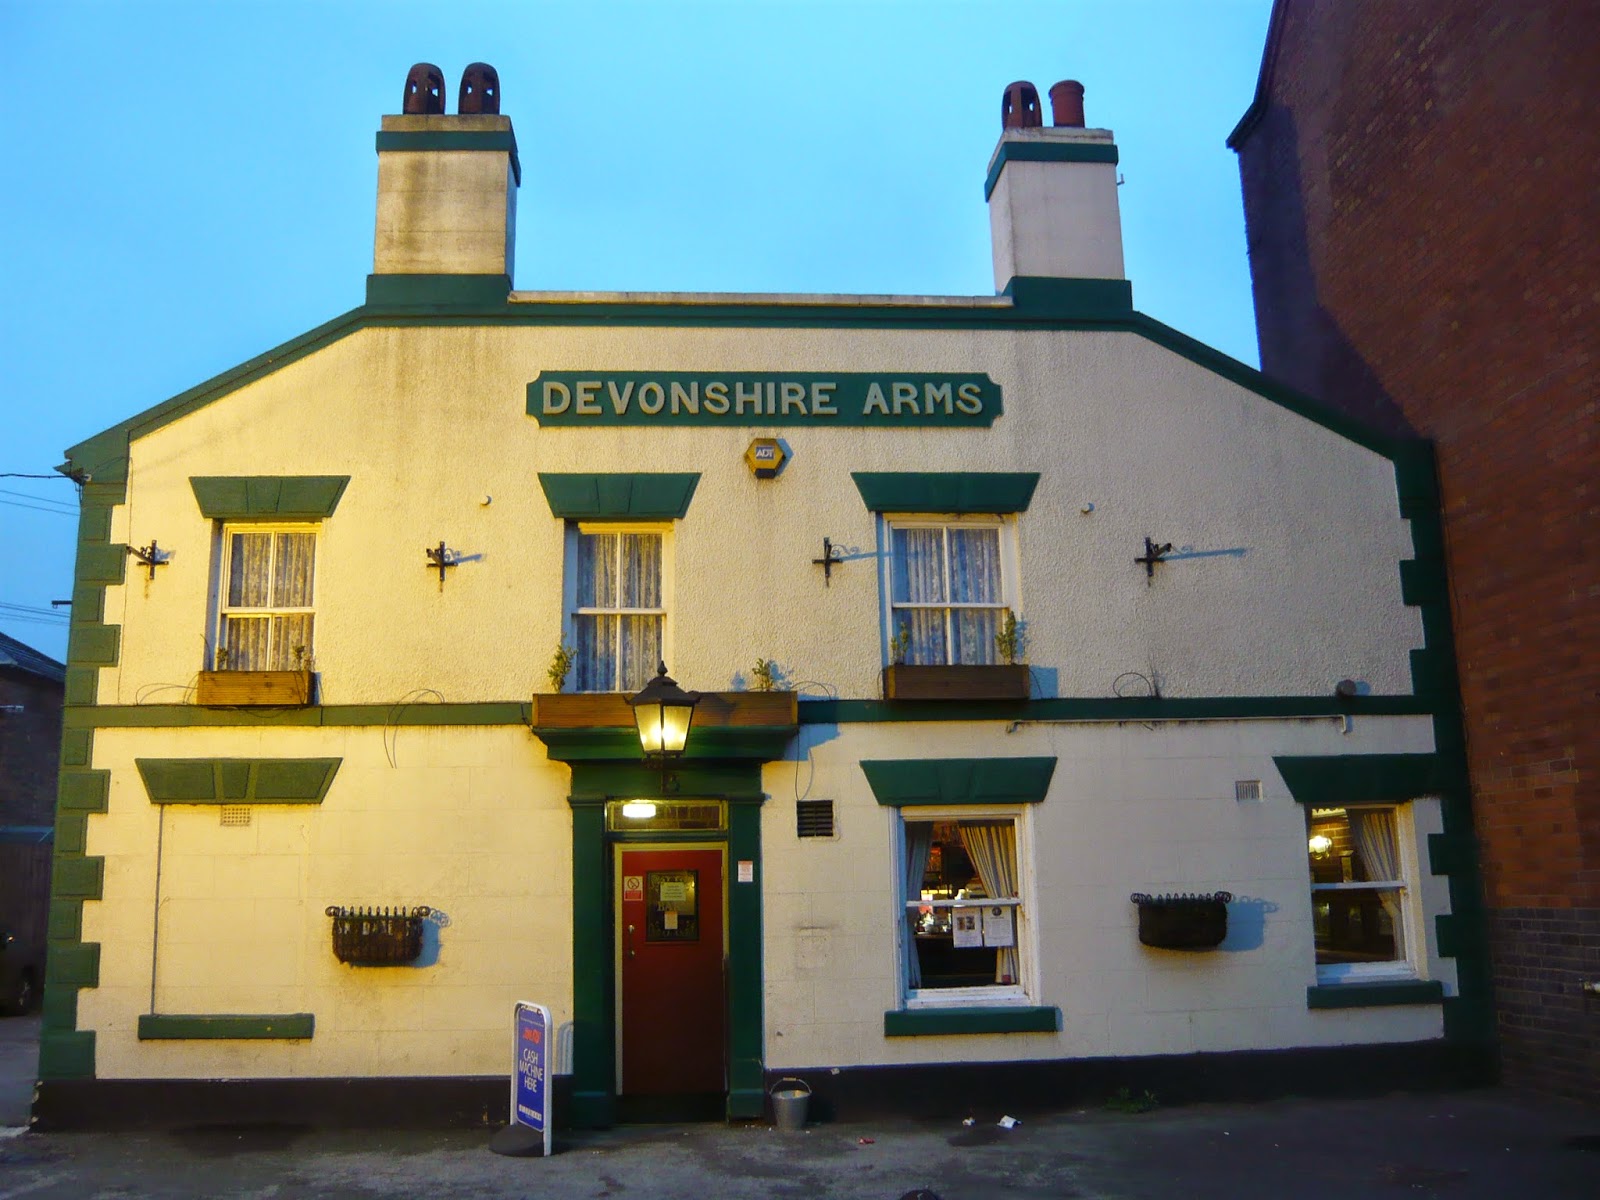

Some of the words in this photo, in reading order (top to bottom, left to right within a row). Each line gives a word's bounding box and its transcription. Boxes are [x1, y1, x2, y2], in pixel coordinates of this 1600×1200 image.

[541, 380, 839, 416] DEVONSHIRE
[862, 381, 985, 416] ARMS
[756, 448, 774, 458] ADT
[523, 1048, 539, 1066] CASH
[519, 1059, 543, 1081] MACHINE
[524, 1075, 537, 1093] HERE
